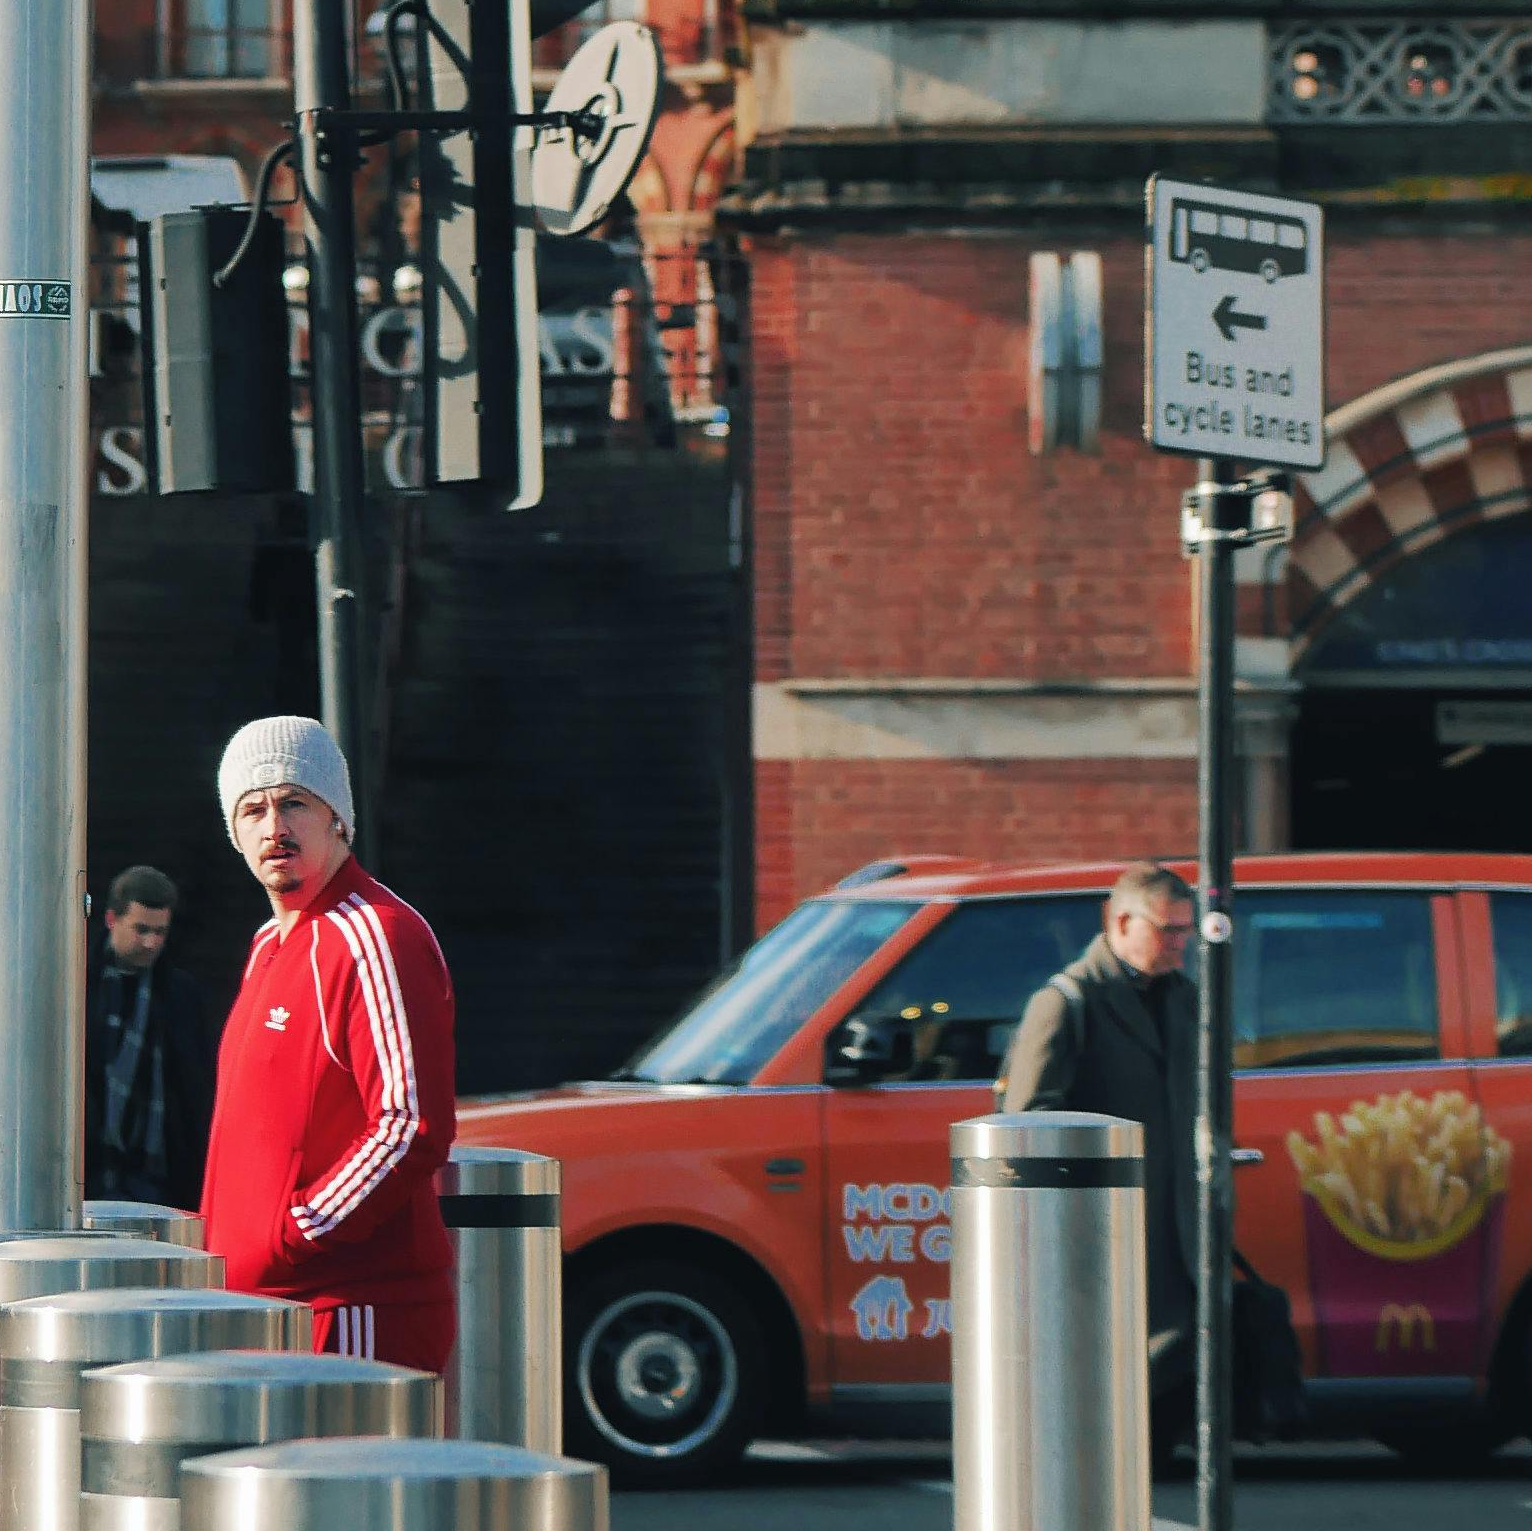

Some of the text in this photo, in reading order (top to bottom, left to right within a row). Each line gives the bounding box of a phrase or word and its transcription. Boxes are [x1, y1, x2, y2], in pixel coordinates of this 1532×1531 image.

[1186, 349, 1295, 398] Bus and
[1164, 398, 1312, 446] cycle lanes
[843, 1182, 953, 1221] MCD
[842, 1225, 916, 1262] WE
